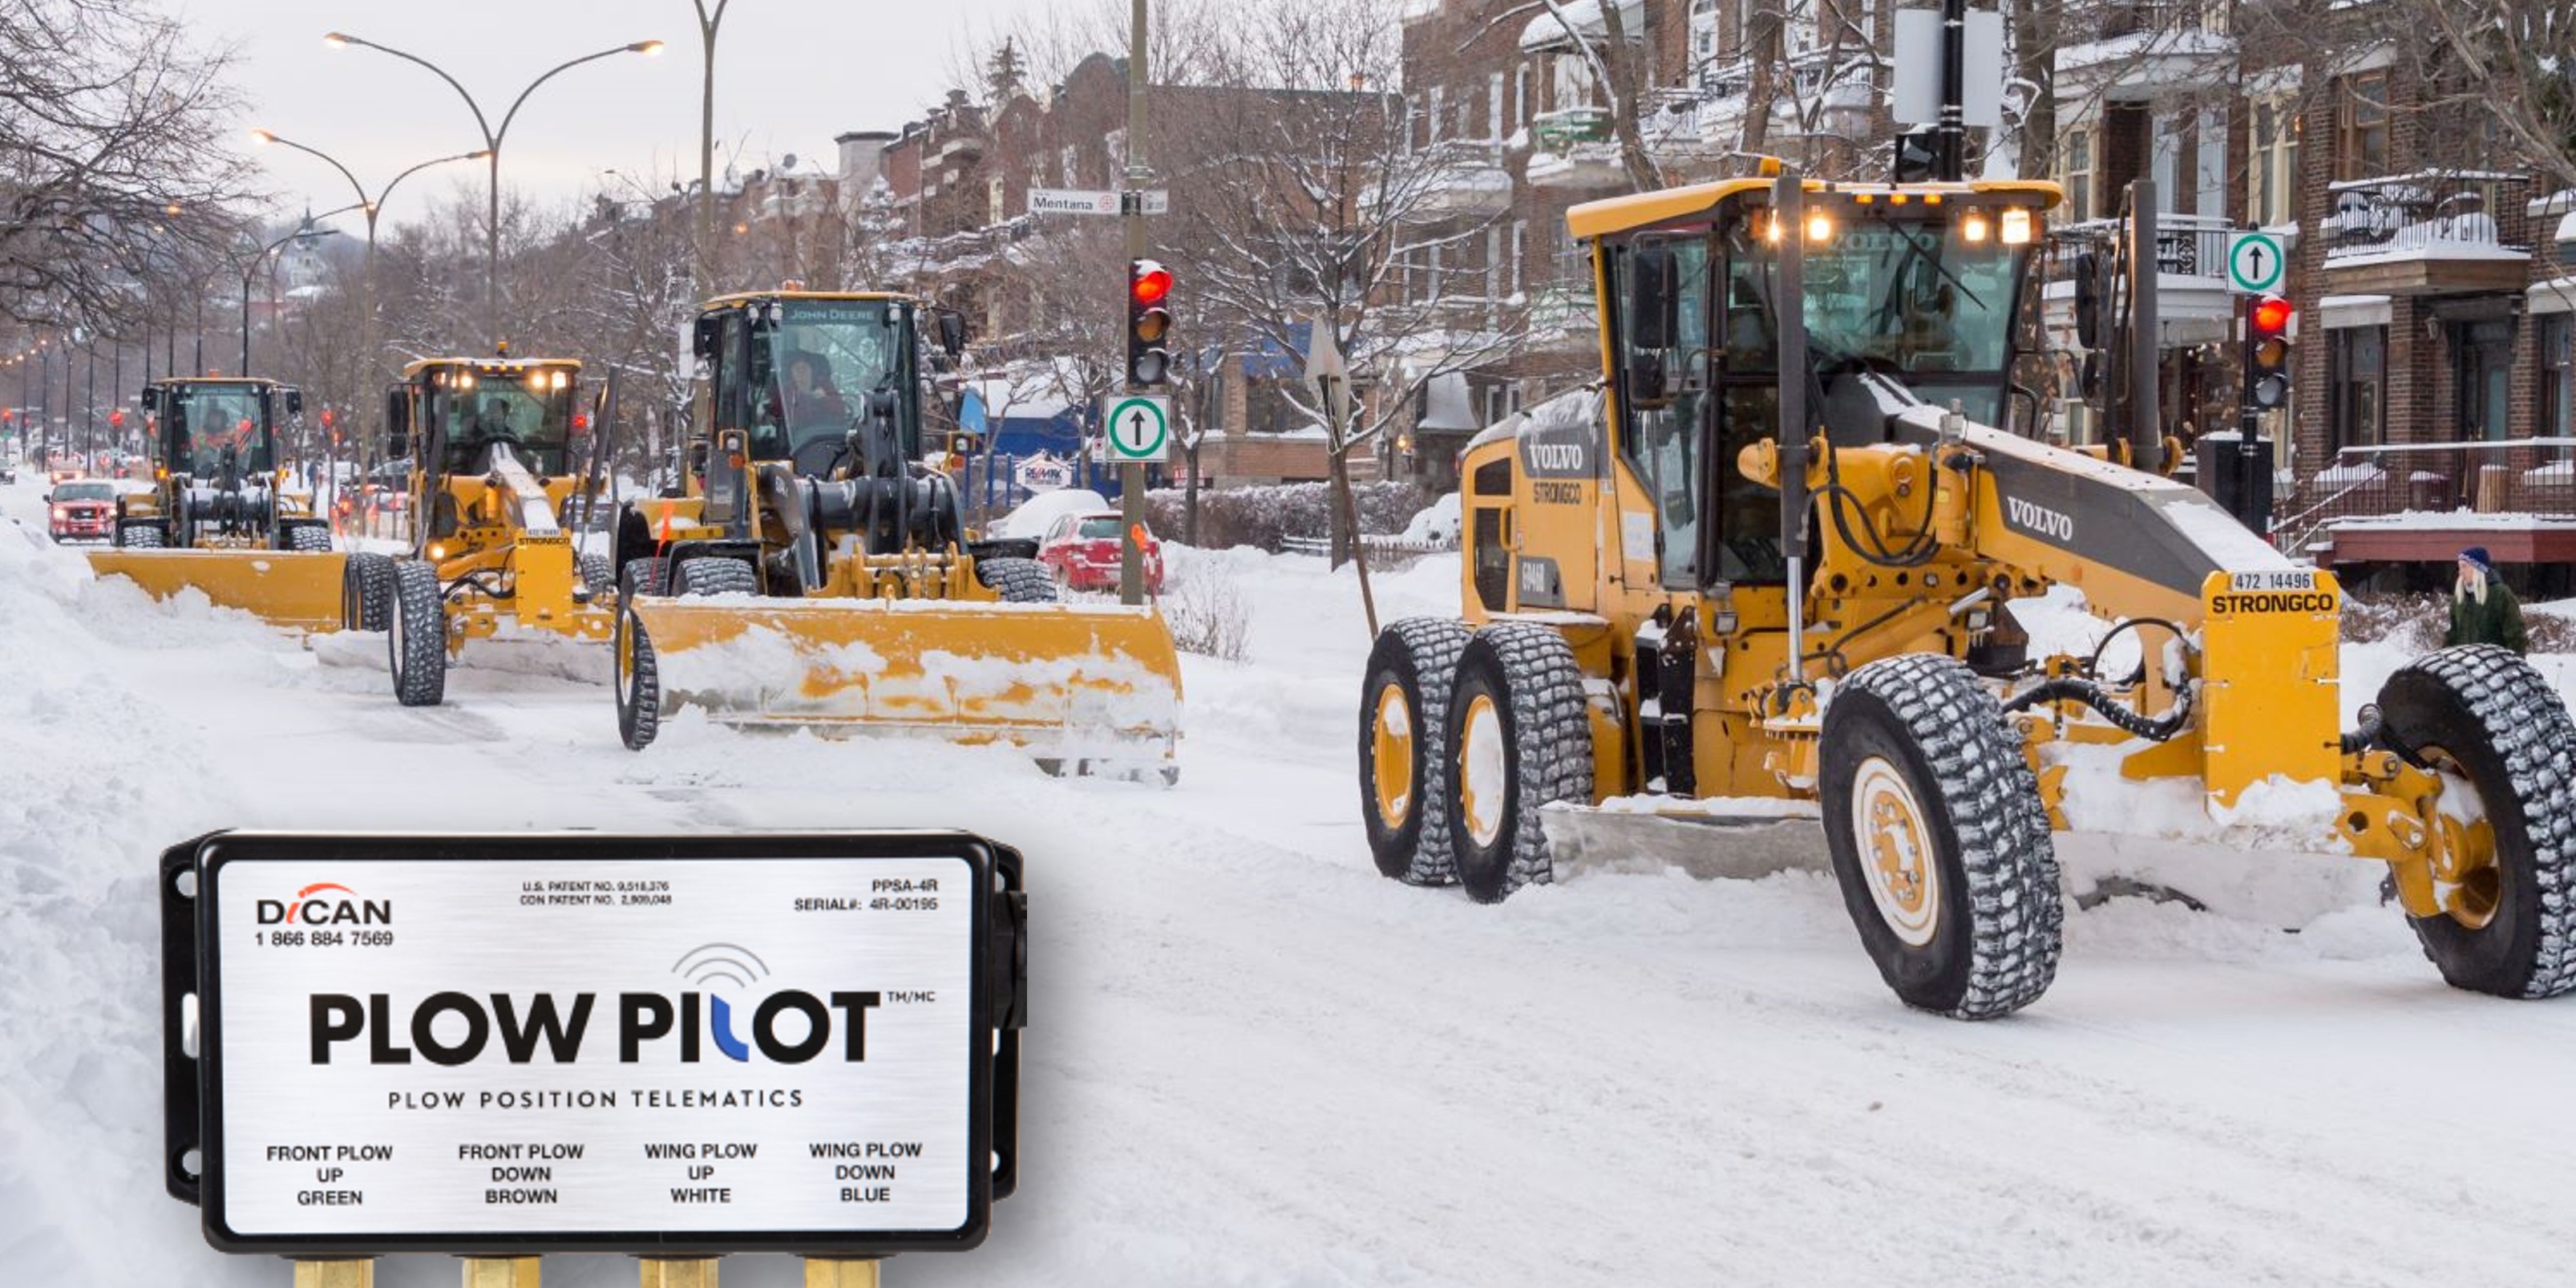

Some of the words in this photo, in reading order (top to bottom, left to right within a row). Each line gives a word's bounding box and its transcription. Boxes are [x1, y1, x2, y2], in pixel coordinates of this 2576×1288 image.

[1033, 197, 1093, 210] Mentana
[791, 310, 827, 320] JOHN
[830, 310, 874, 320] DEERE
[1530, 444, 1583, 470] VOLVO
[1534, 483, 1581, 504] STRONGCO
[2008, 496, 2073, 541] VOLVO
[2235, 573, 2260, 589] 472
[2270, 573, 2310, 589] 14496
[2213, 594, 2333, 614] STRONGCO
[548, 881, 592, 892] PATENT
[594, 881, 615, 892] NO.
[872, 879, 938, 892] PPSA-4R
[548, 895, 592, 905] PATENT
[594, 895, 615, 905] NO.
[795, 898, 862, 911] SERIAL#:
[256, 932, 263, 946] 1
[272, 931, 305, 946] 866
[311, 931, 343, 946] 884
[350, 931, 394, 946] 7569
[310, 991, 596, 1067] PLOW
[620, 990, 880, 1064] PILOT
[389, 1092, 465, 1109] PLOW
[480, 1091, 616, 1109] POSITION
[632, 1090, 803, 1108] TELEMATICS
[267, 1145, 331, 1160] FRONT
[338, 1145, 393, 1160] PLOW
[459, 1144, 523, 1160] FRONT
[528, 1144, 584, 1159] PLOW
[645, 1144, 695, 1159] WING
[702, 1144, 758, 1159] PLOW
[810, 1143, 860, 1158] WING
[866, 1142, 922, 1157] PLOW
[317, 1168, 343, 1182] UP
[492, 1167, 551, 1182] DOWN
[689, 1165, 714, 1180] UP
[835, 1165, 895, 1180] DOWN
[297, 1191, 362, 1205] GREEN
[486, 1189, 556, 1204] BROWN
[671, 1188, 730, 1203] WHITE
[841, 1187, 890, 1202] BLUE
